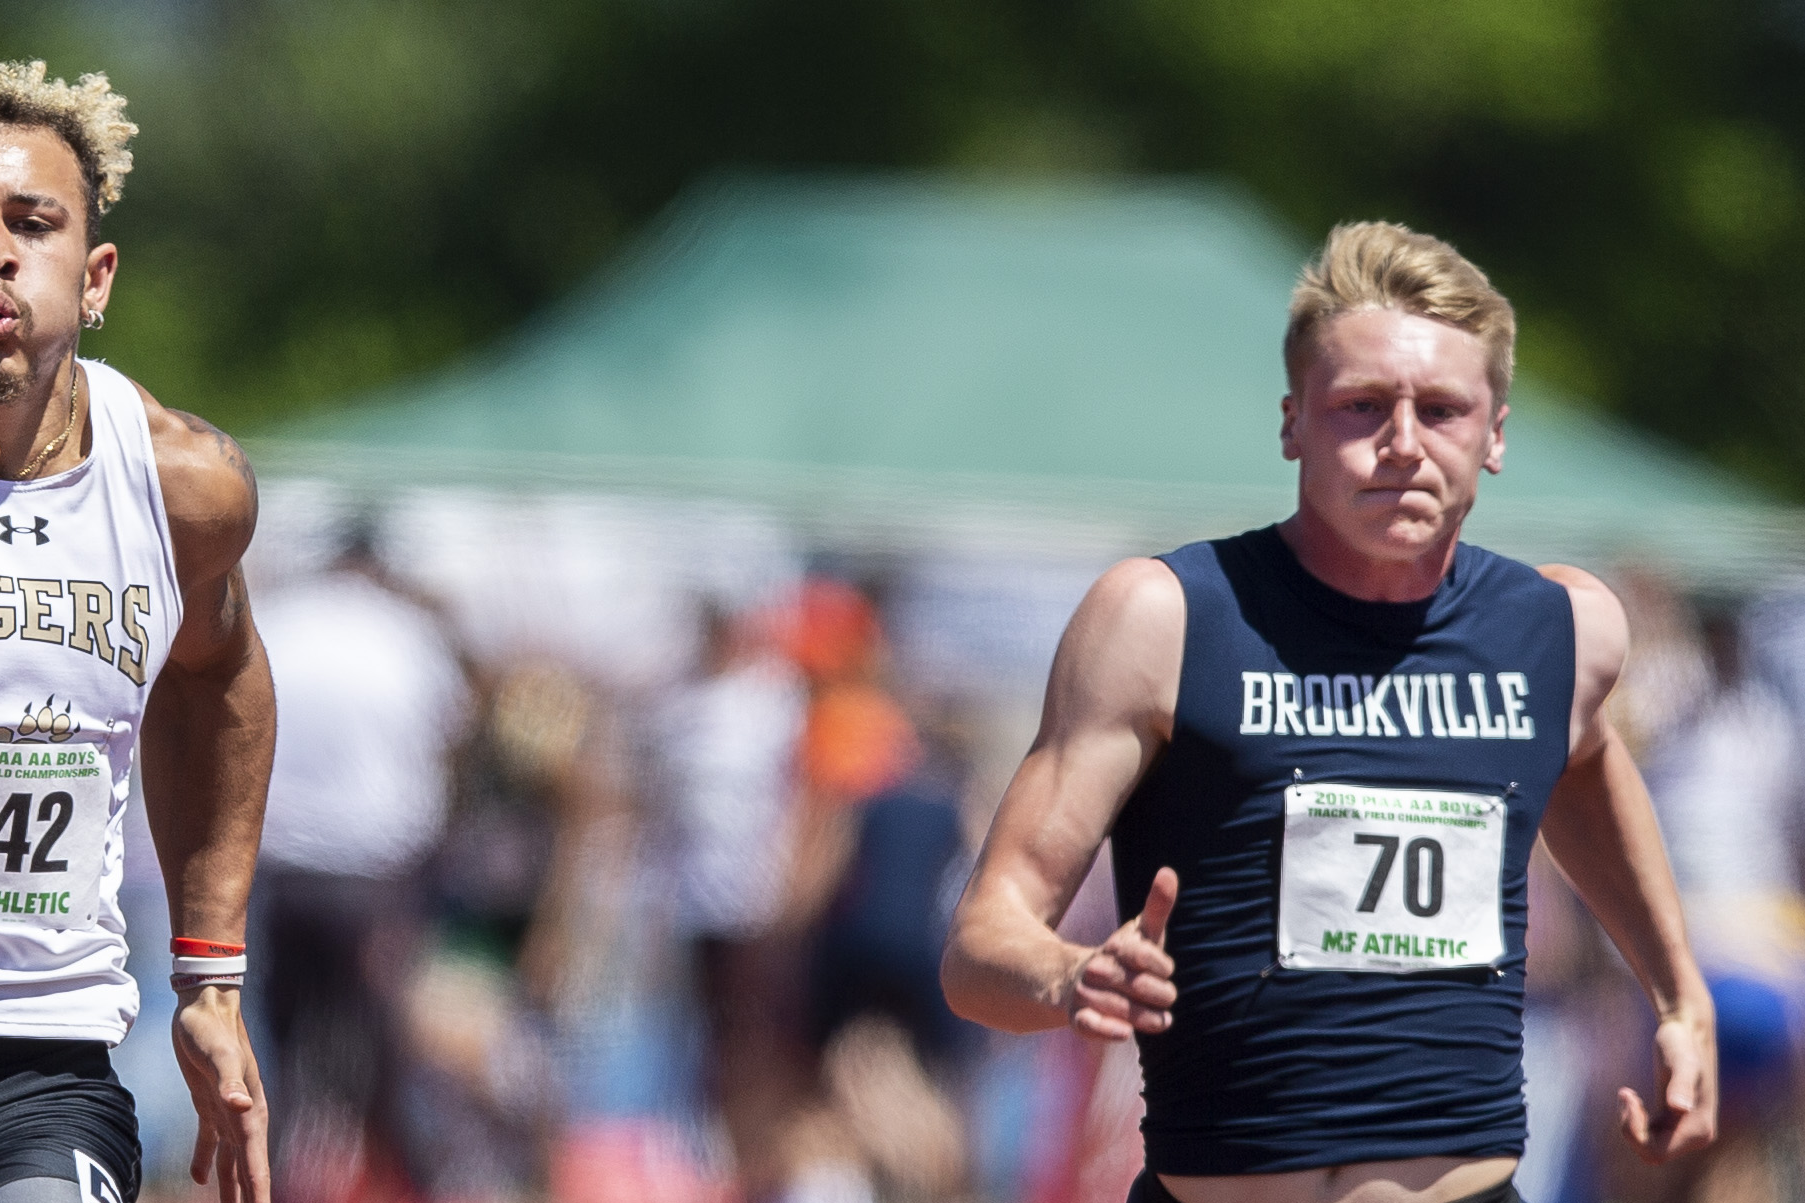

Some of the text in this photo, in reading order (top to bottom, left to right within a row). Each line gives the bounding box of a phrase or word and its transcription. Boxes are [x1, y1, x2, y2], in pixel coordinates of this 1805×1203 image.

[1239, 671, 1536, 740] BROOKVILLE
[28, 752, 52, 766] AA
[56, 751, 96, 766] BOYS
[15, 767, 100, 779] CHAMPIONSHIPS
[1314, 791, 1356, 806] 2019
[1410, 798, 1434, 812] AA
[1439, 800, 1484, 816] BOYS
[1364, 811, 1395, 822] FIELD
[1353, 832, 1445, 919] 70
[1321, 929, 1469, 960] MF ATHLETIC
